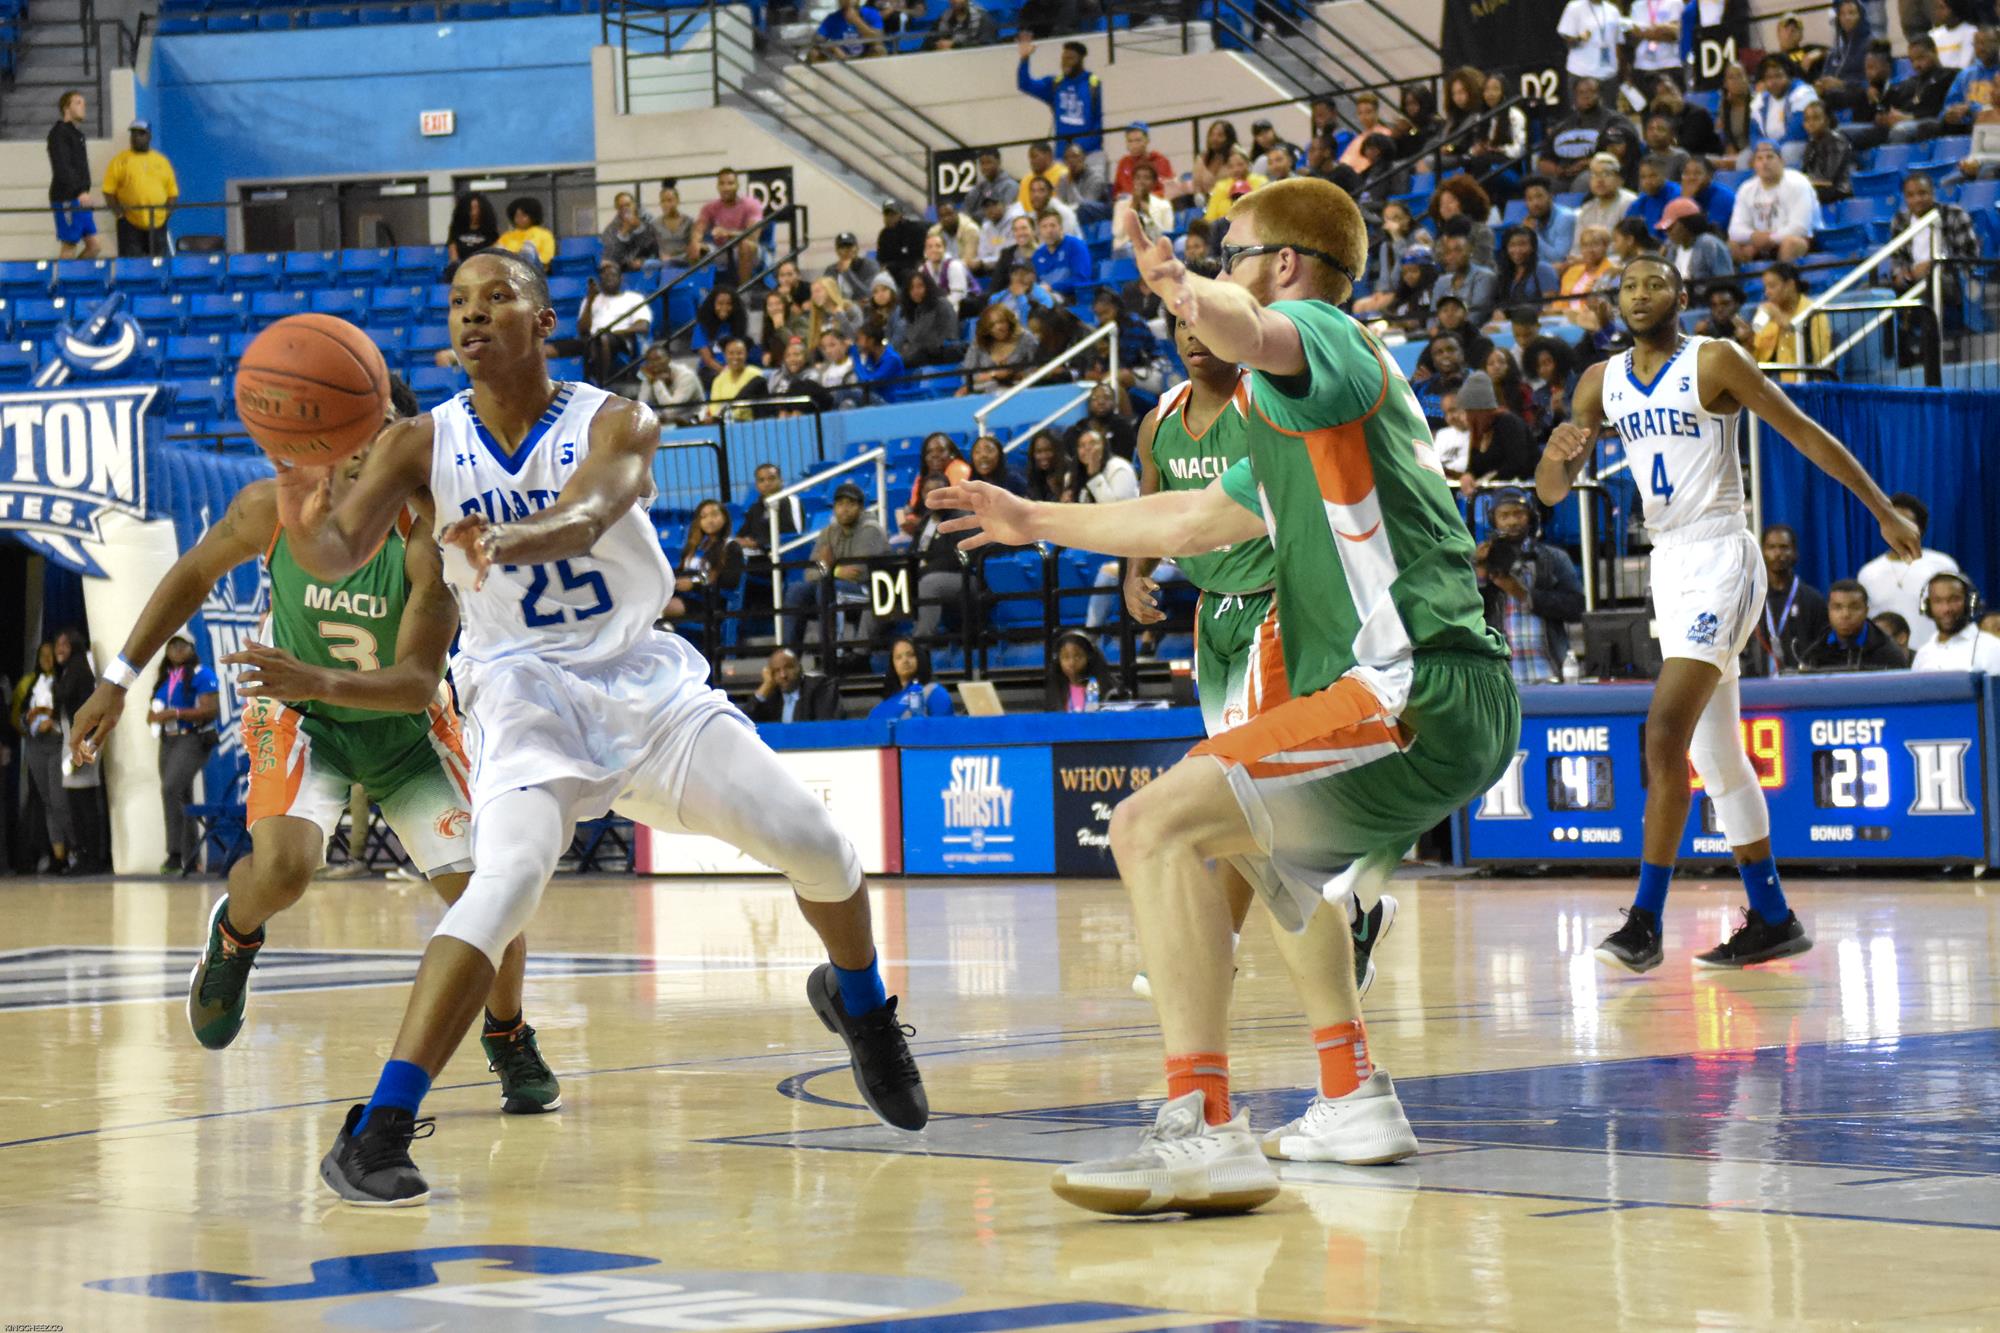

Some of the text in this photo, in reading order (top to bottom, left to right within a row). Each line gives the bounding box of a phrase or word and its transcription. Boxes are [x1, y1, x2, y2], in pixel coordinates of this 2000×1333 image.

[1702, 37, 1737, 78] D1
[1521, 70, 1559, 105] D2
[423, 112, 449, 132] EXIT
[749, 180, 787, 211] D3
[938, 161, 977, 195] D2
[1168, 456, 1229, 479] MACU
[1651, 452, 1675, 506] 4
[304, 584, 388, 619] MACU
[503, 559, 614, 628] 25
[871, 568, 911, 617] D1
[318, 620, 381, 672] 3
[1547, 726, 1610, 752] HOME
[1811, 719, 1886, 746] GUEST
[950, 755, 1004, 792] STILL
[1060, 766, 1127, 792] WHOV
[1560, 755, 1590, 808] 4
[1831, 747, 1890, 808] 23
[1903, 737, 1976, 816] H
[941, 788, 1014, 828] THIRSTY
[1581, 827, 1623, 843] BONUS
[1810, 825, 1855, 841] BONUS
